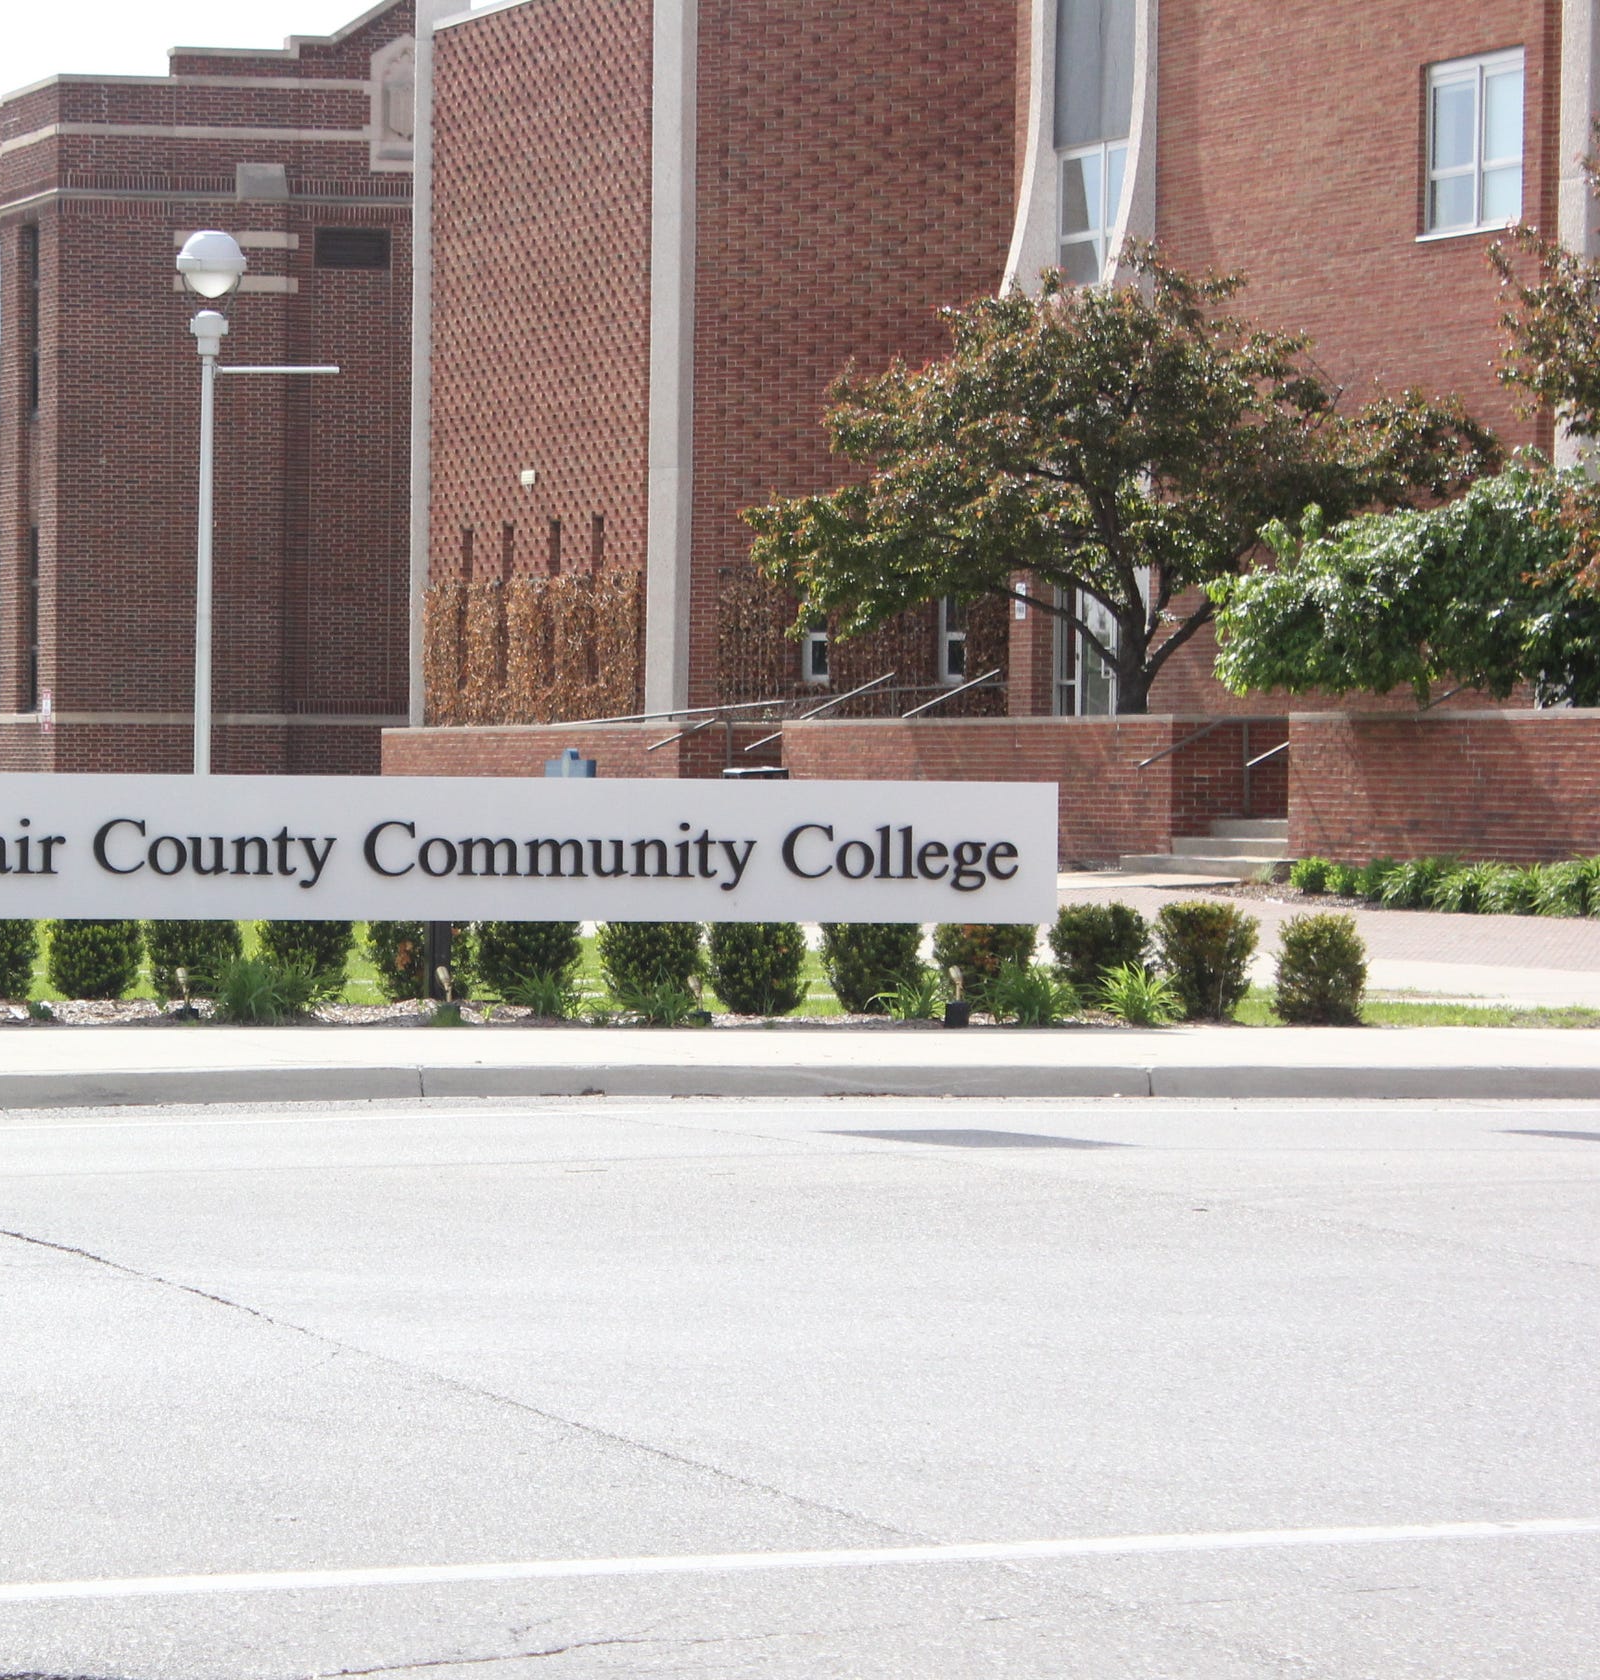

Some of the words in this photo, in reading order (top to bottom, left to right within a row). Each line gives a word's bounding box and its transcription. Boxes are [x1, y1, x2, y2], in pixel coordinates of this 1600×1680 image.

[93, 818, 338, 889] County
[363, 820, 758, 891] Community
[781, 823, 1019, 892] College
